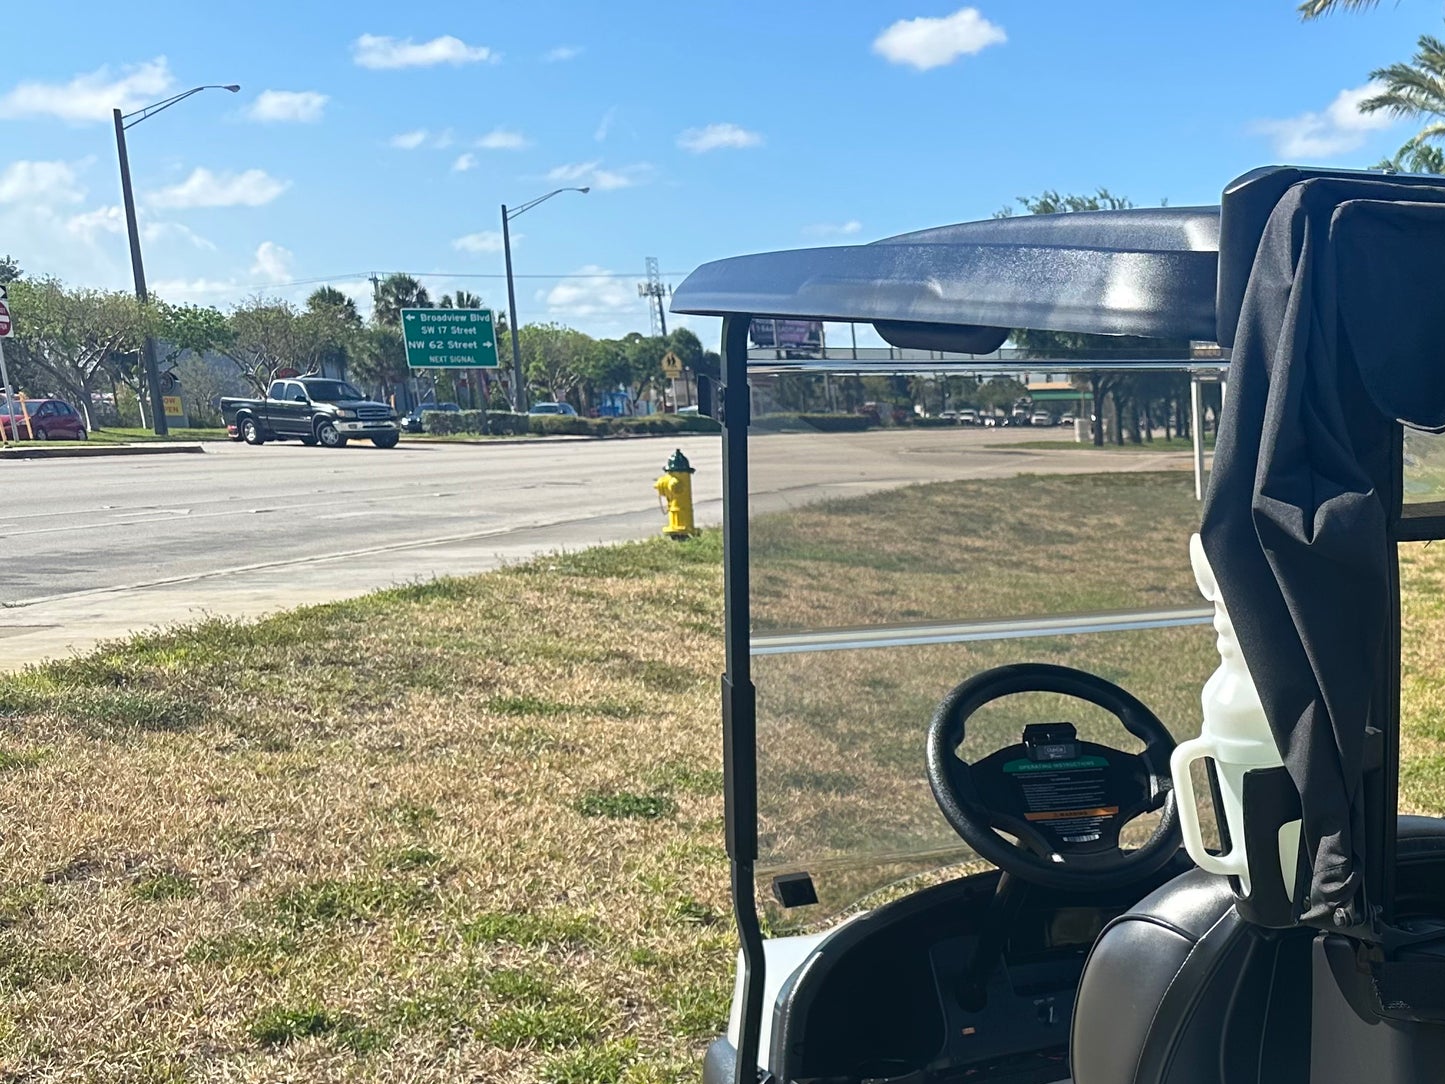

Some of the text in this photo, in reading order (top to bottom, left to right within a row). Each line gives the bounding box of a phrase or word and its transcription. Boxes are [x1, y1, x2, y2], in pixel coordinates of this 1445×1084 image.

[420, 313, 490, 322] Broadview Blvd
[421, 326, 477, 335] SW 17 Street
[408, 341, 478, 349] NW 62 Street
[429, 355, 476, 363] NEXT SIGNAL
